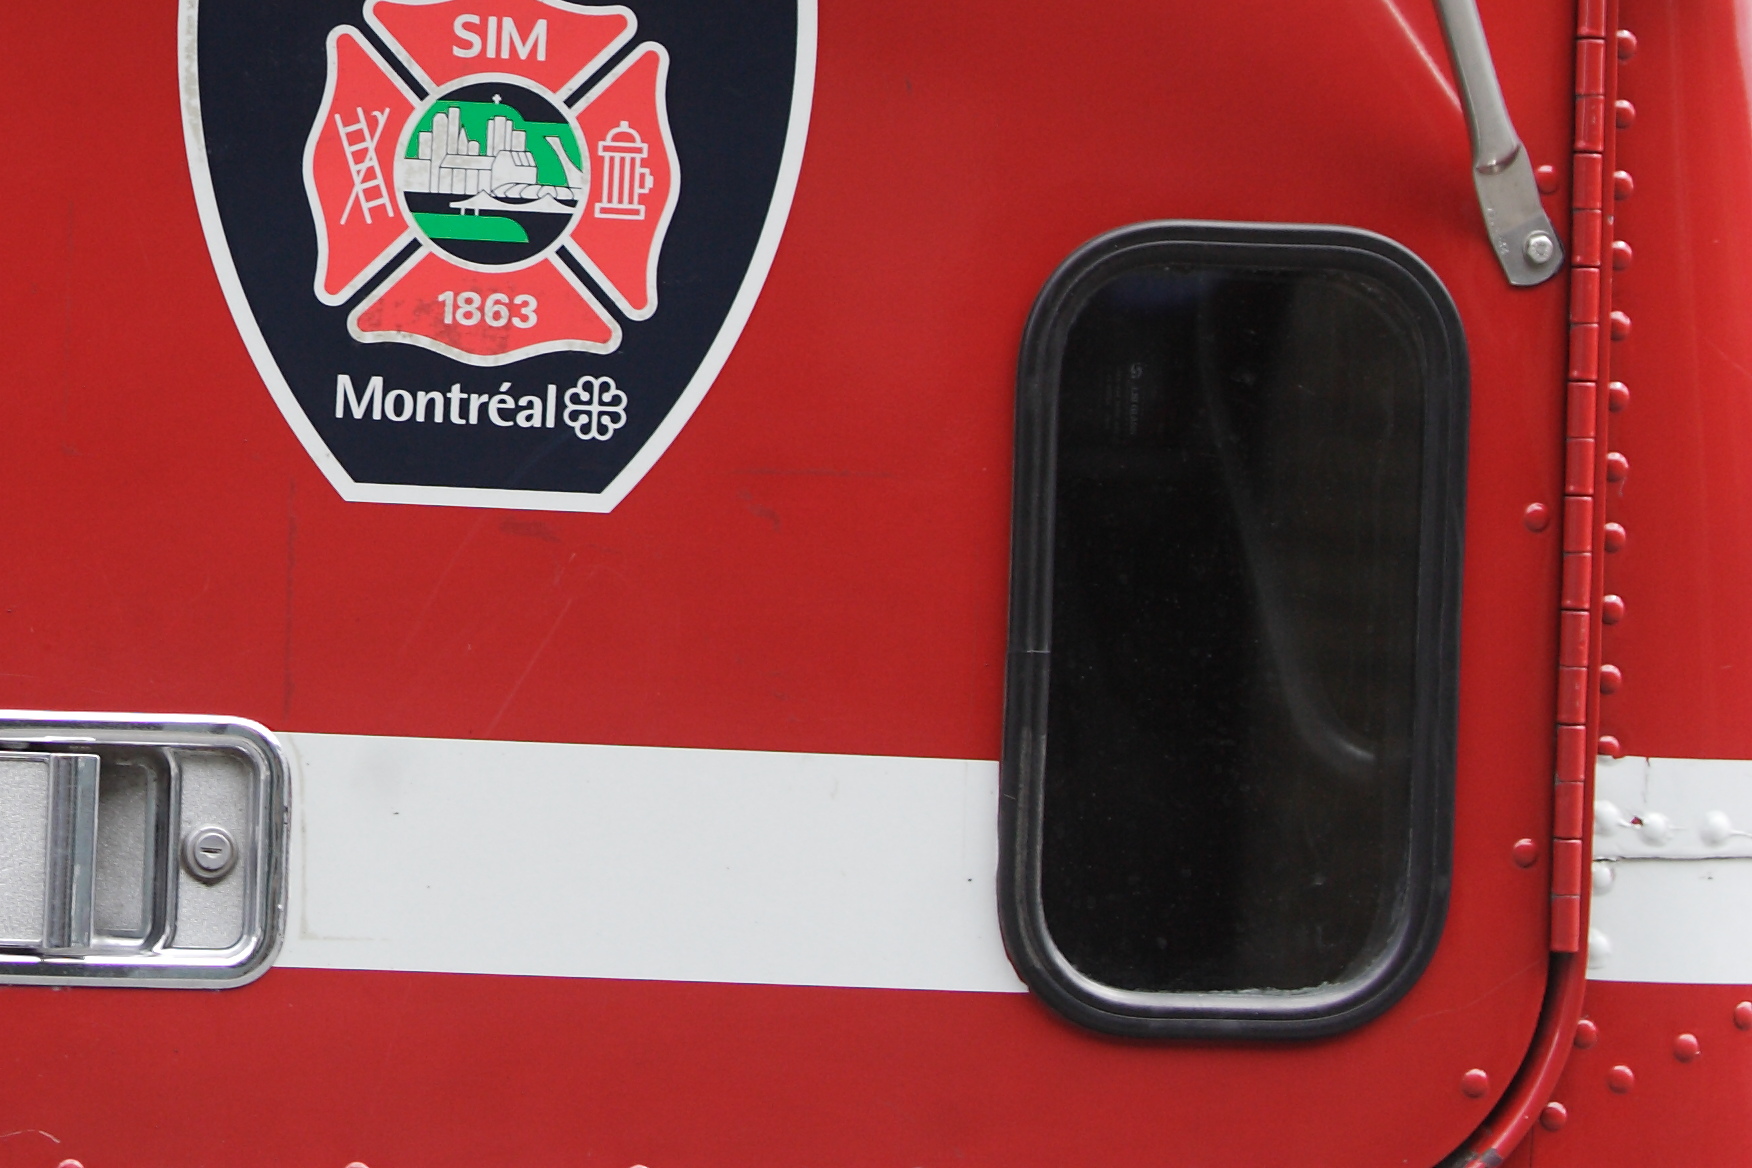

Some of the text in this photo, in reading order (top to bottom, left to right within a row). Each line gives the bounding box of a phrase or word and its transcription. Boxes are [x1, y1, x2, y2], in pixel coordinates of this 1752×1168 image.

[452, 13, 548, 62] SIM
[437, 290, 538, 329] 1863
[335, 373, 557, 429] Montréal
